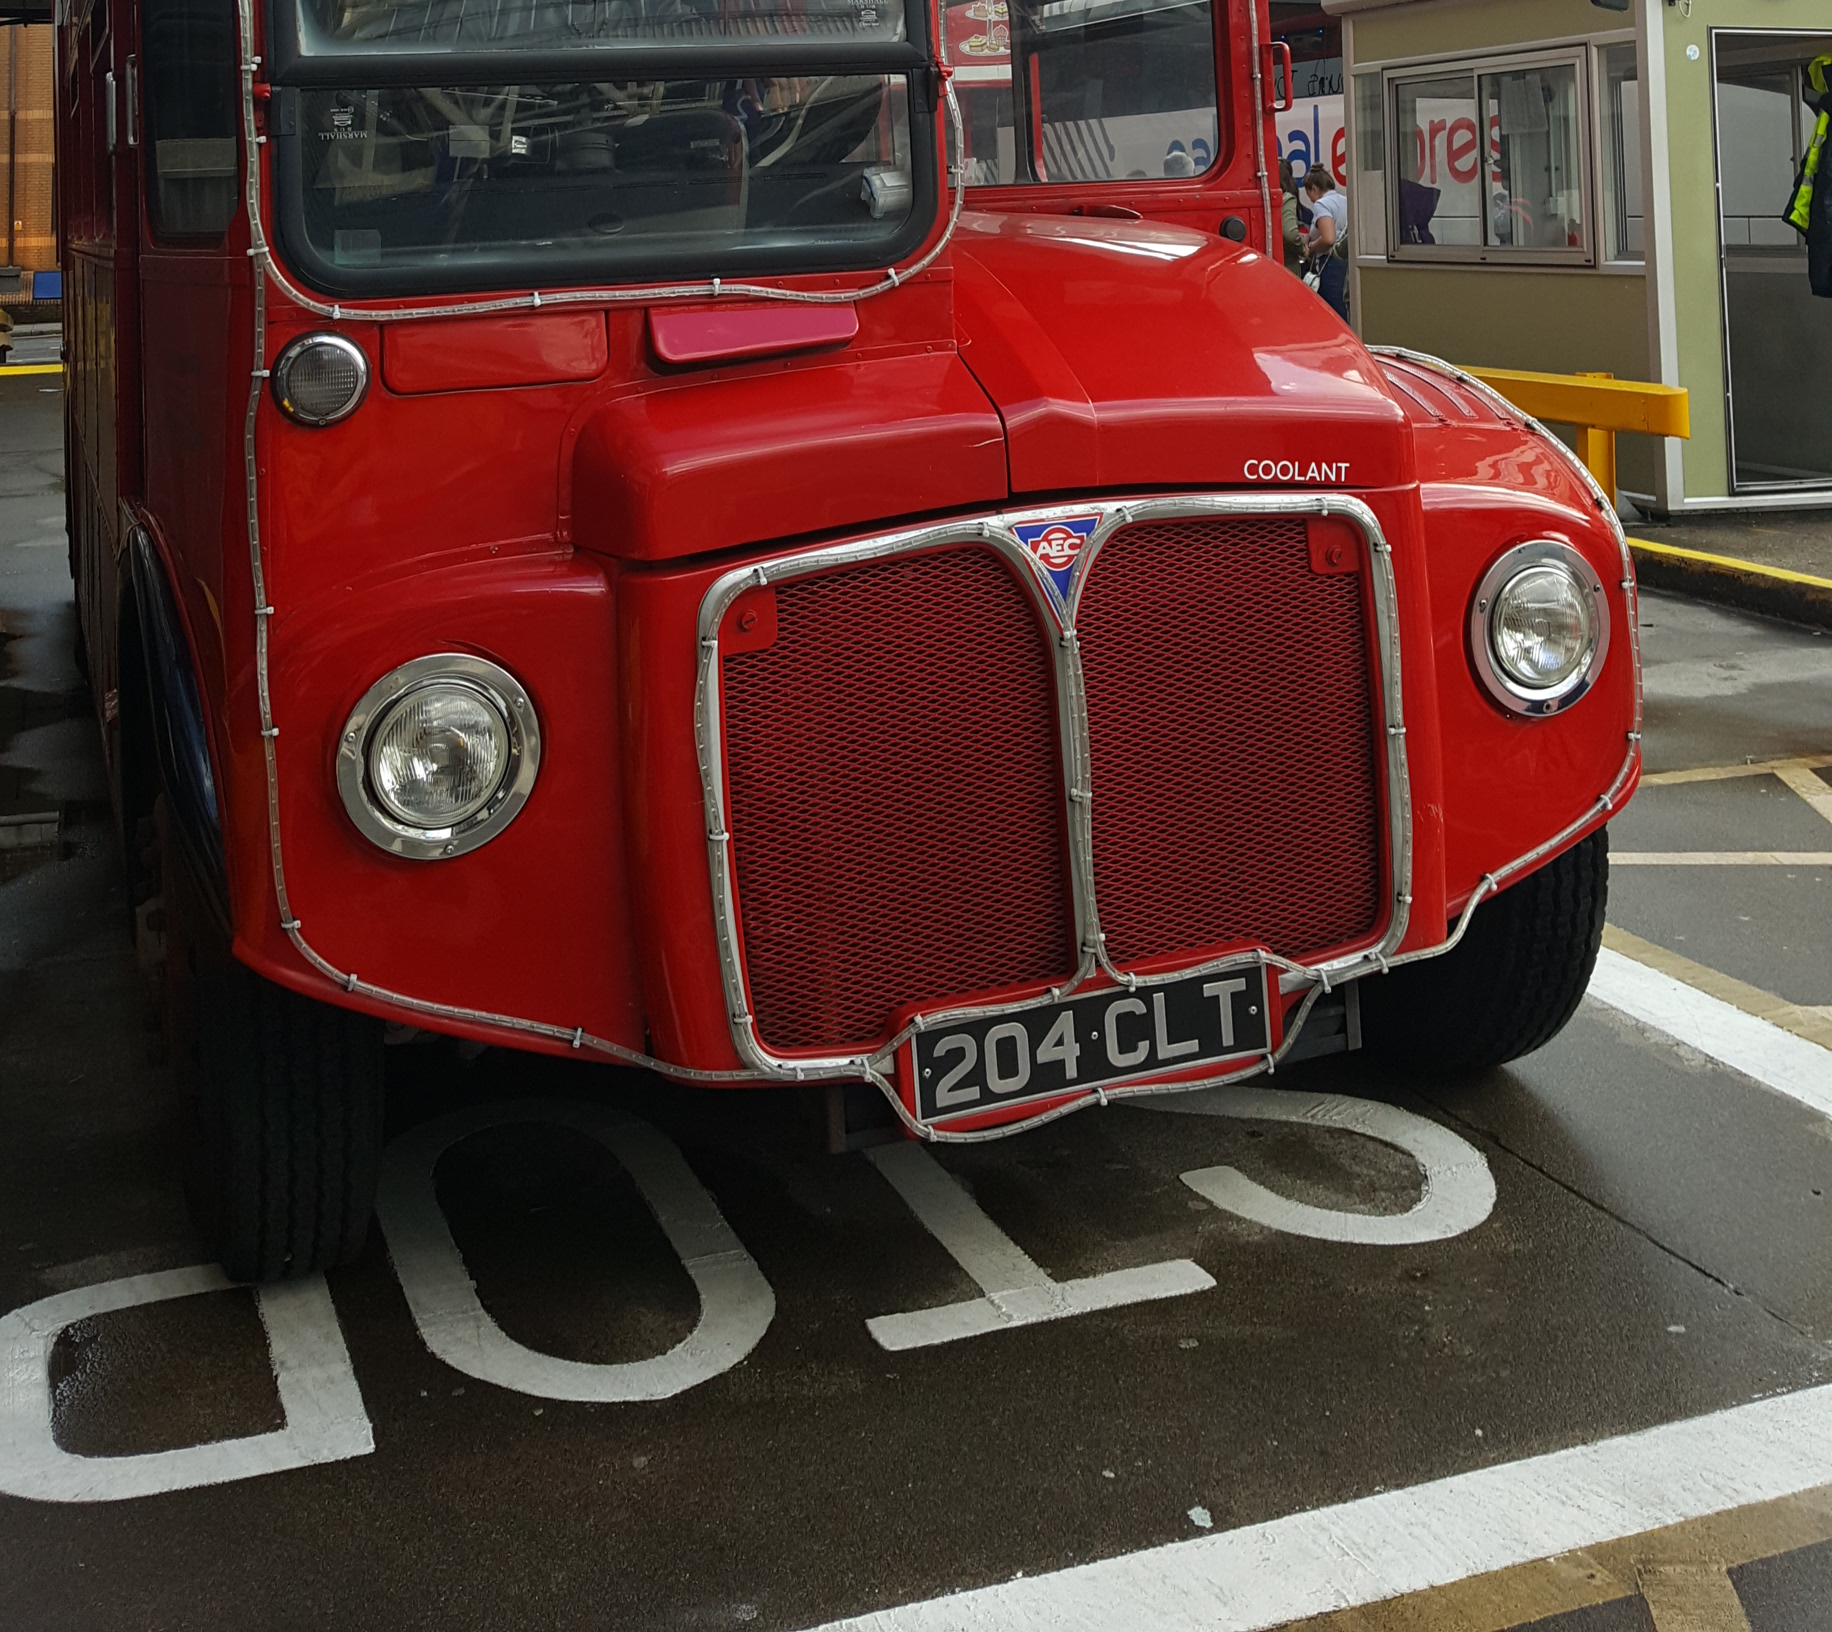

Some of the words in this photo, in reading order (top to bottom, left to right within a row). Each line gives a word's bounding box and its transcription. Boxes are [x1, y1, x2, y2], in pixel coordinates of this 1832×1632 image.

[318, 131, 368, 140] MARSHALL
[1243, 458, 1351, 483] COOLANT
[1036, 538, 1081, 559] AEC
[931, 1009, 1080, 1109] 204
[1103, 977, 1247, 1069] CLT
